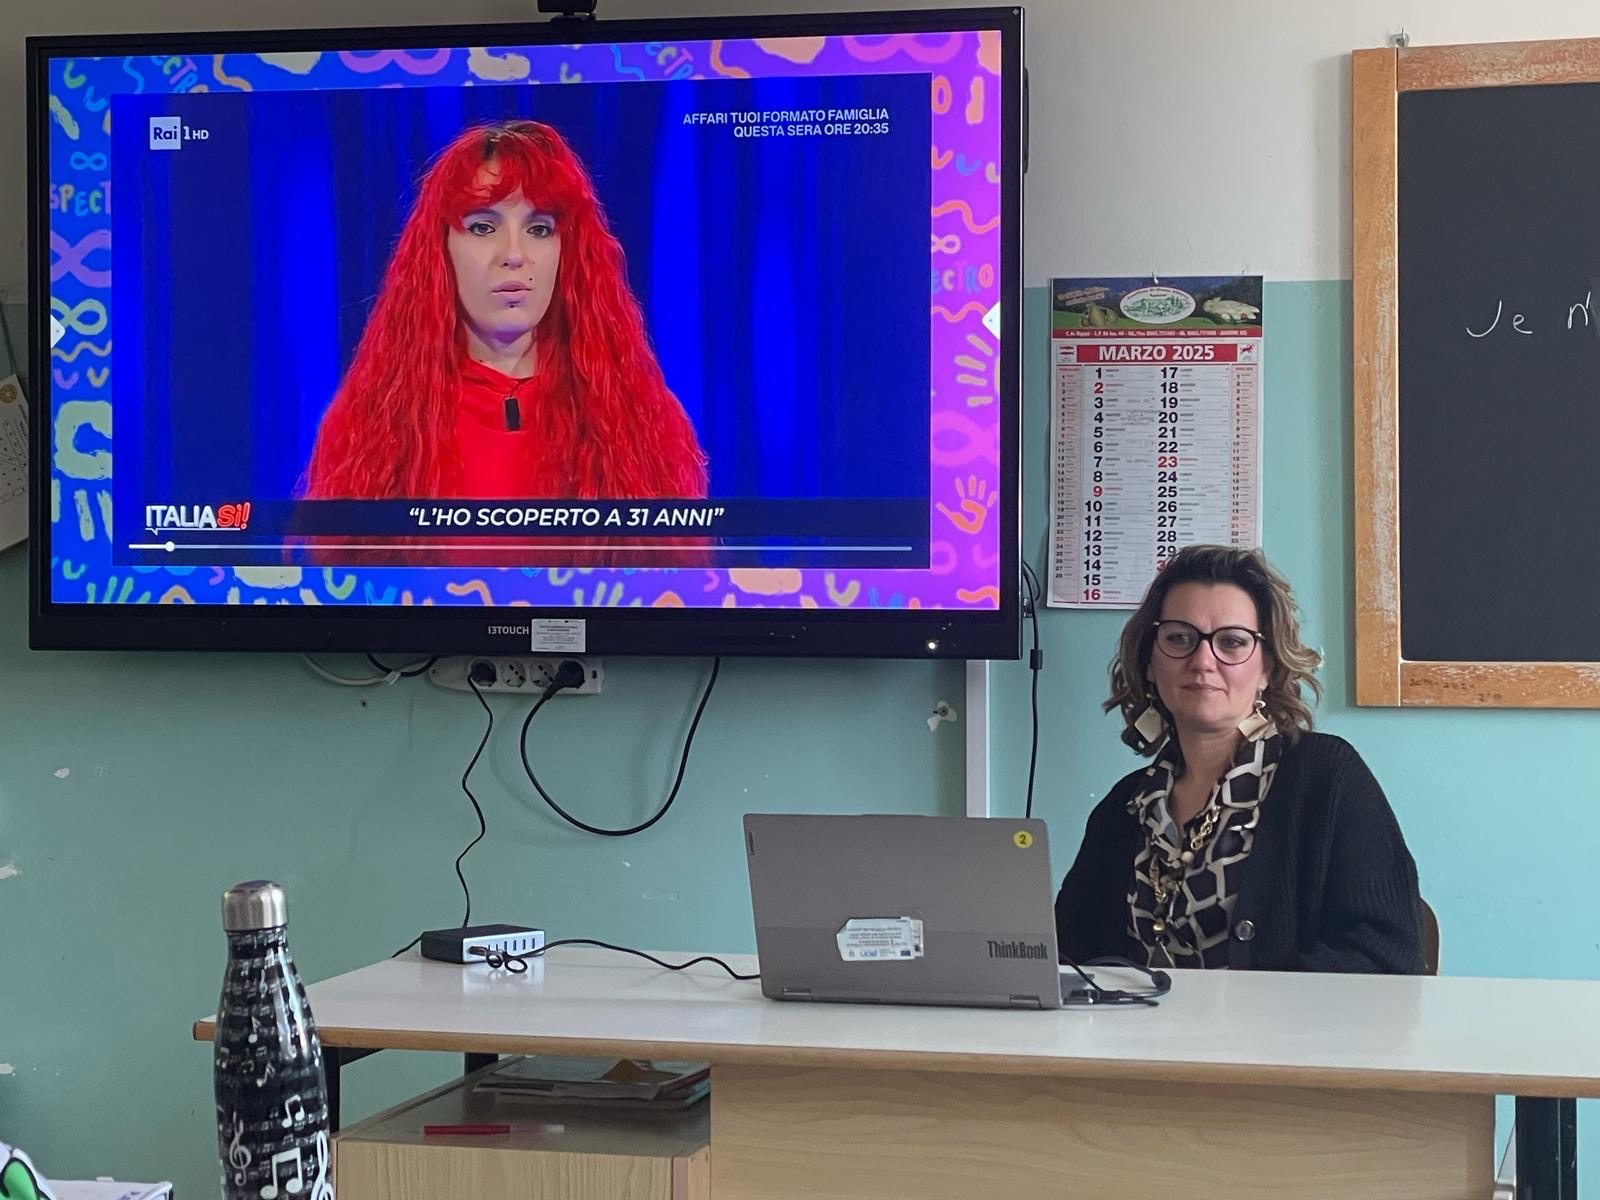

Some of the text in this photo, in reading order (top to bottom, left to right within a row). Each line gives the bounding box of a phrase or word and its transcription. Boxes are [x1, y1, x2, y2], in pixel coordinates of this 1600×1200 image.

[683, 108, 889, 125] AFFARI TUOI FORMATO FAMIGLIA
[153, 126, 178, 140] Rai
[733, 122, 889, 138] QUESTA SERA ORE 20:35
[1467, 300, 1533, 338] Je
[1099, 345, 1215, 361] MARZO 2025
[1095, 368, 1101, 379] 1
[1161, 367, 1178, 378] 17
[1093, 382, 1103, 393] 2
[1161, 382, 1178, 393] 18
[1093, 397, 1103, 408] 3
[1161, 397, 1178, 408] 19
[1093, 412, 1103, 423] 4
[1159, 412, 1178, 423] 20
[1093, 427, 1103, 438] 5
[1159, 427, 1175, 438] 21
[1093, 441, 1103, 453] 6
[1159, 442, 1178, 453] 22
[1093, 456, 1102, 467] 7
[1158, 457, 1177, 467] 23
[1093, 471, 1102, 482] 8
[1158, 472, 1177, 482] 24
[1093, 486, 1102, 497] 9
[1158, 486, 1177, 497] 25
[1083, 500, 1102, 512] 10
[1157, 501, 1177, 512] 26
[476, 508, 600, 526] SCOPERTO
[604, 508, 622, 526] A
[626, 508, 649, 526] 31
[1083, 515, 1100, 526] 11
[1157, 516, 1176, 527] 27
[1083, 530, 1102, 541] 12
[1157, 531, 1176, 542] 28
[1083, 545, 1101, 556] 13
[1157, 546, 1176, 557] 29
[1083, 560, 1101, 571] 14
[1082, 574, 1100, 585] 15
[1082, 589, 1100, 600] 16
[1018, 834, 1027, 845] 2
[986, 940, 1048, 960] ThinkBook
